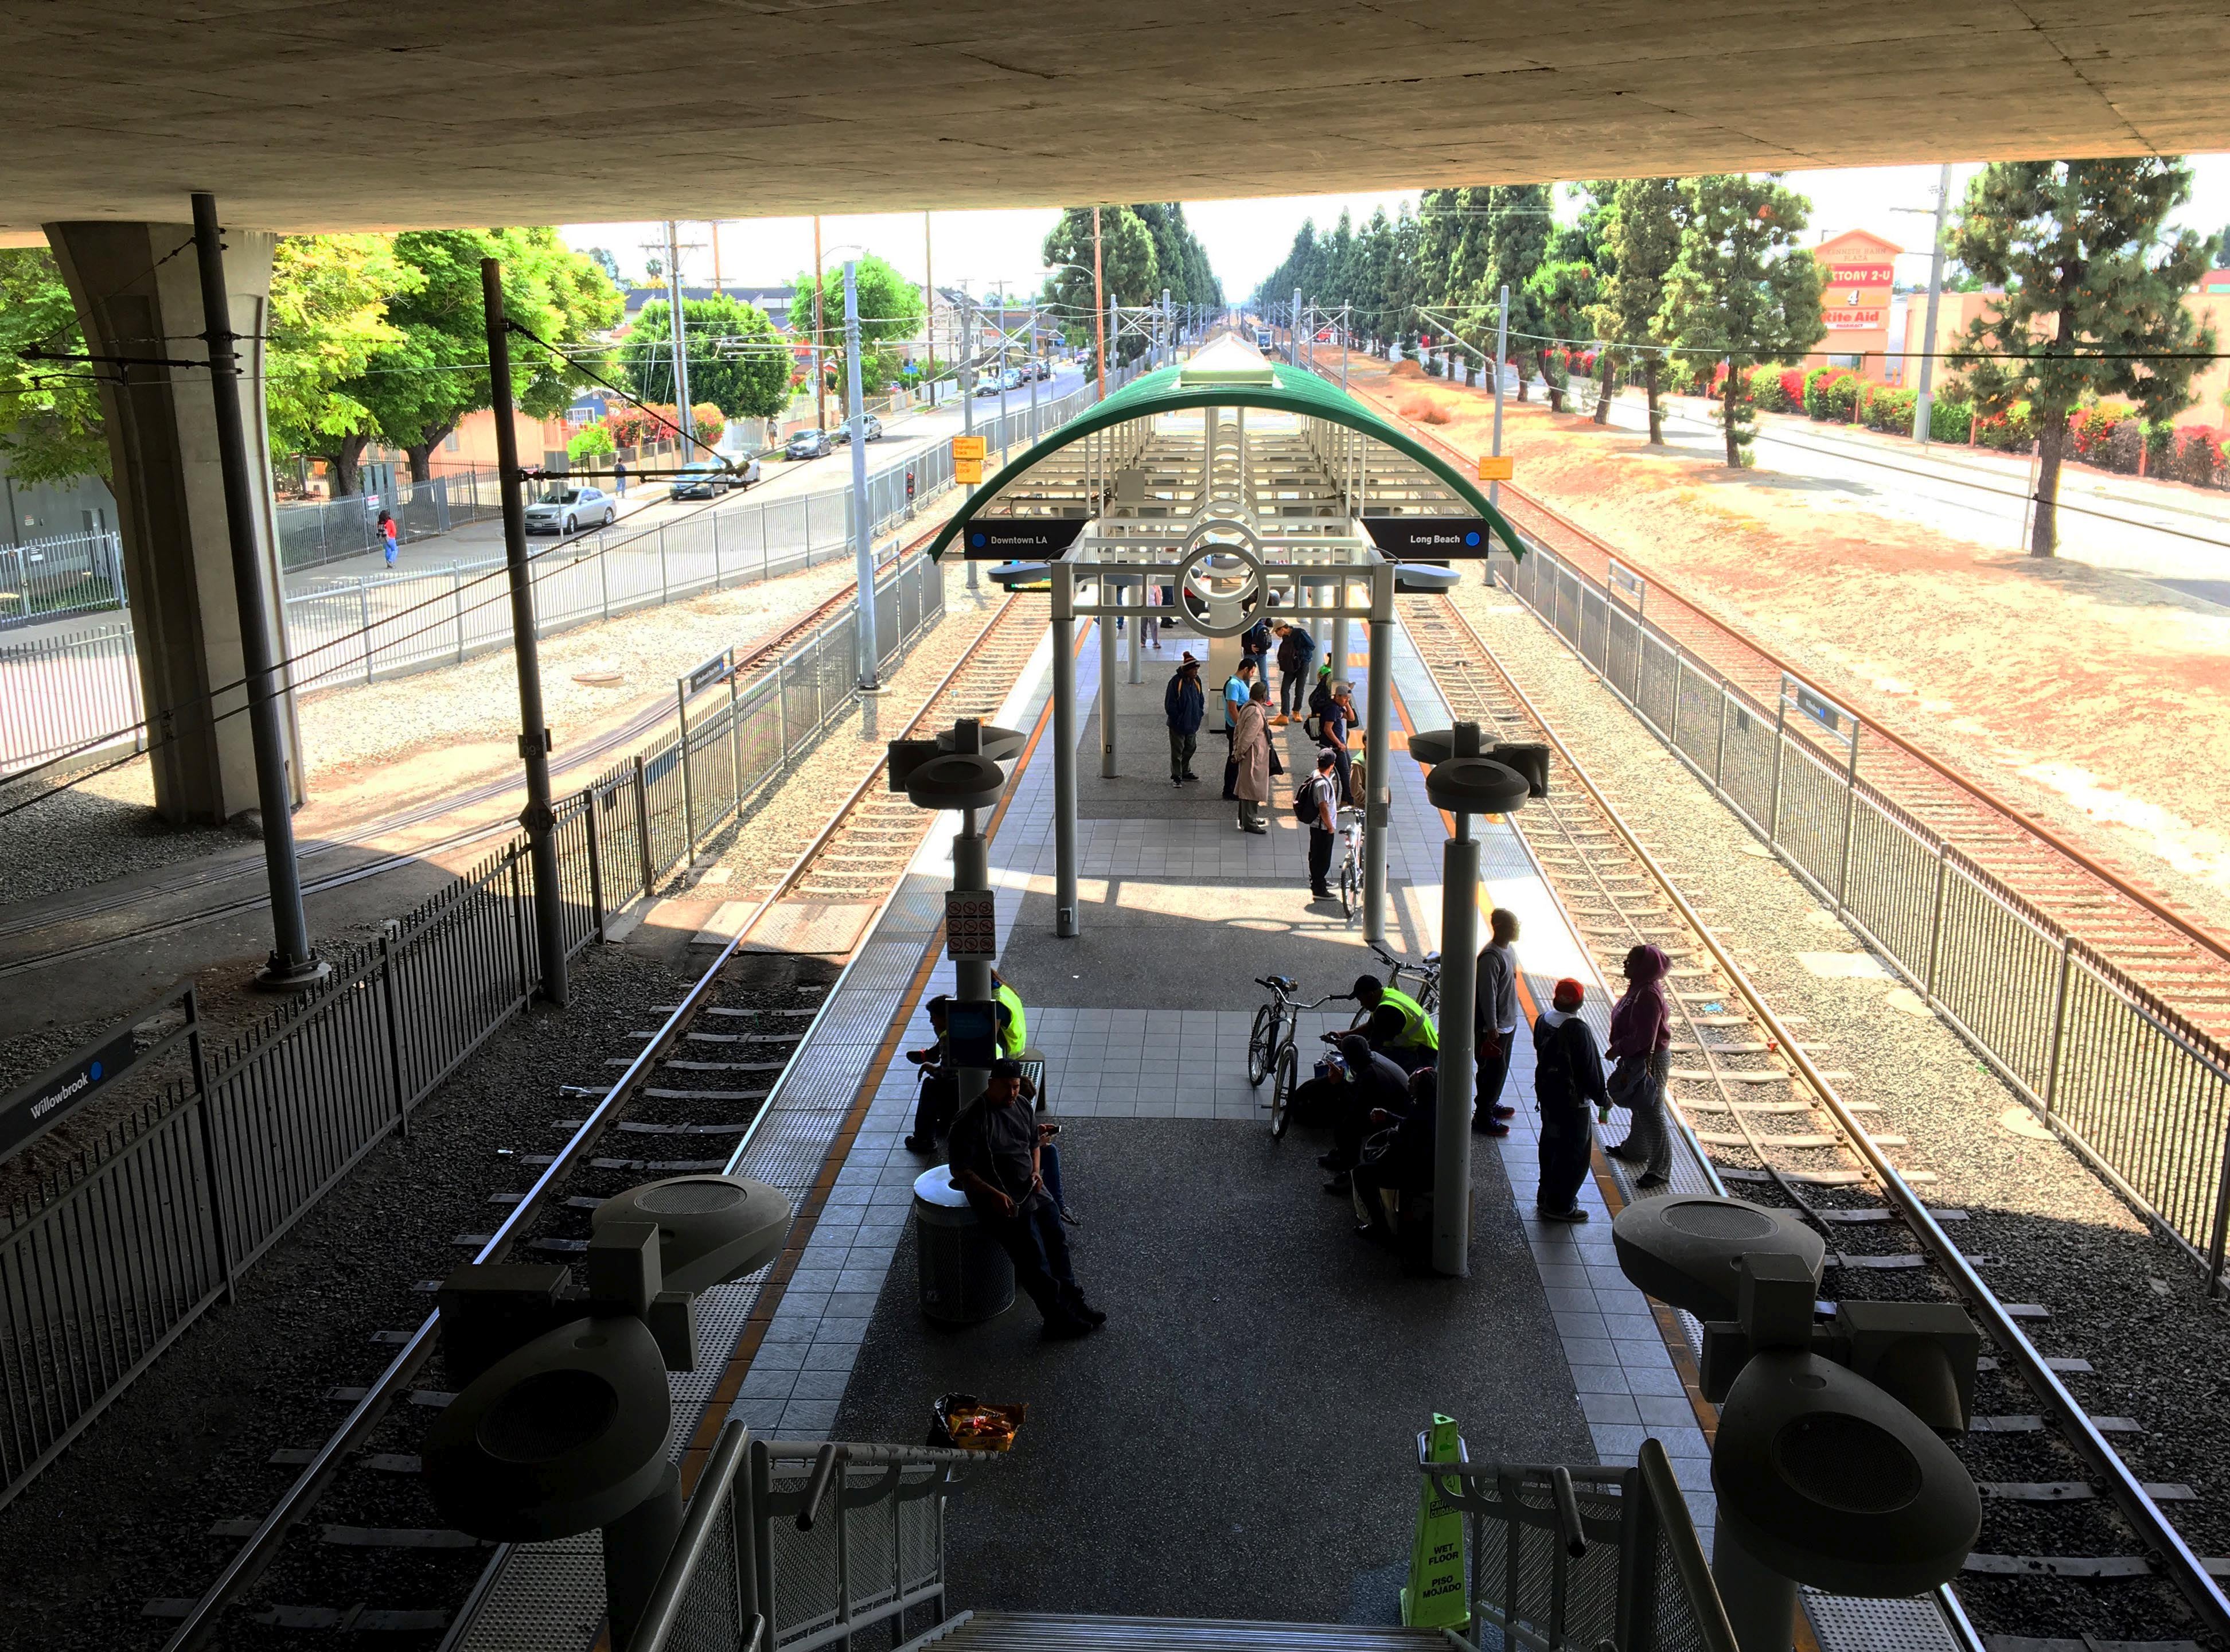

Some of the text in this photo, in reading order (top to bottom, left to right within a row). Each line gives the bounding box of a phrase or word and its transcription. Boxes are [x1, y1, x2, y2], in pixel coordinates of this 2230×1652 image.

[1872, 270, 1890, 280] 2-U
[1847, 289, 1859, 306] 4
[1822, 311, 1880, 322] Rite Aid
[991, 536, 1048, 544] Downtown LA
[1410, 535, 1460, 545] Long Beach
[30, 1072, 89, 1119] Willowbrook
[1434, 1543, 1454, 1554] WET
[1428, 1552, 1459, 1565] FLOOR
[1432, 1575, 1453, 1588] PISO
[1422, 1583, 1461, 1599] MOJADO
